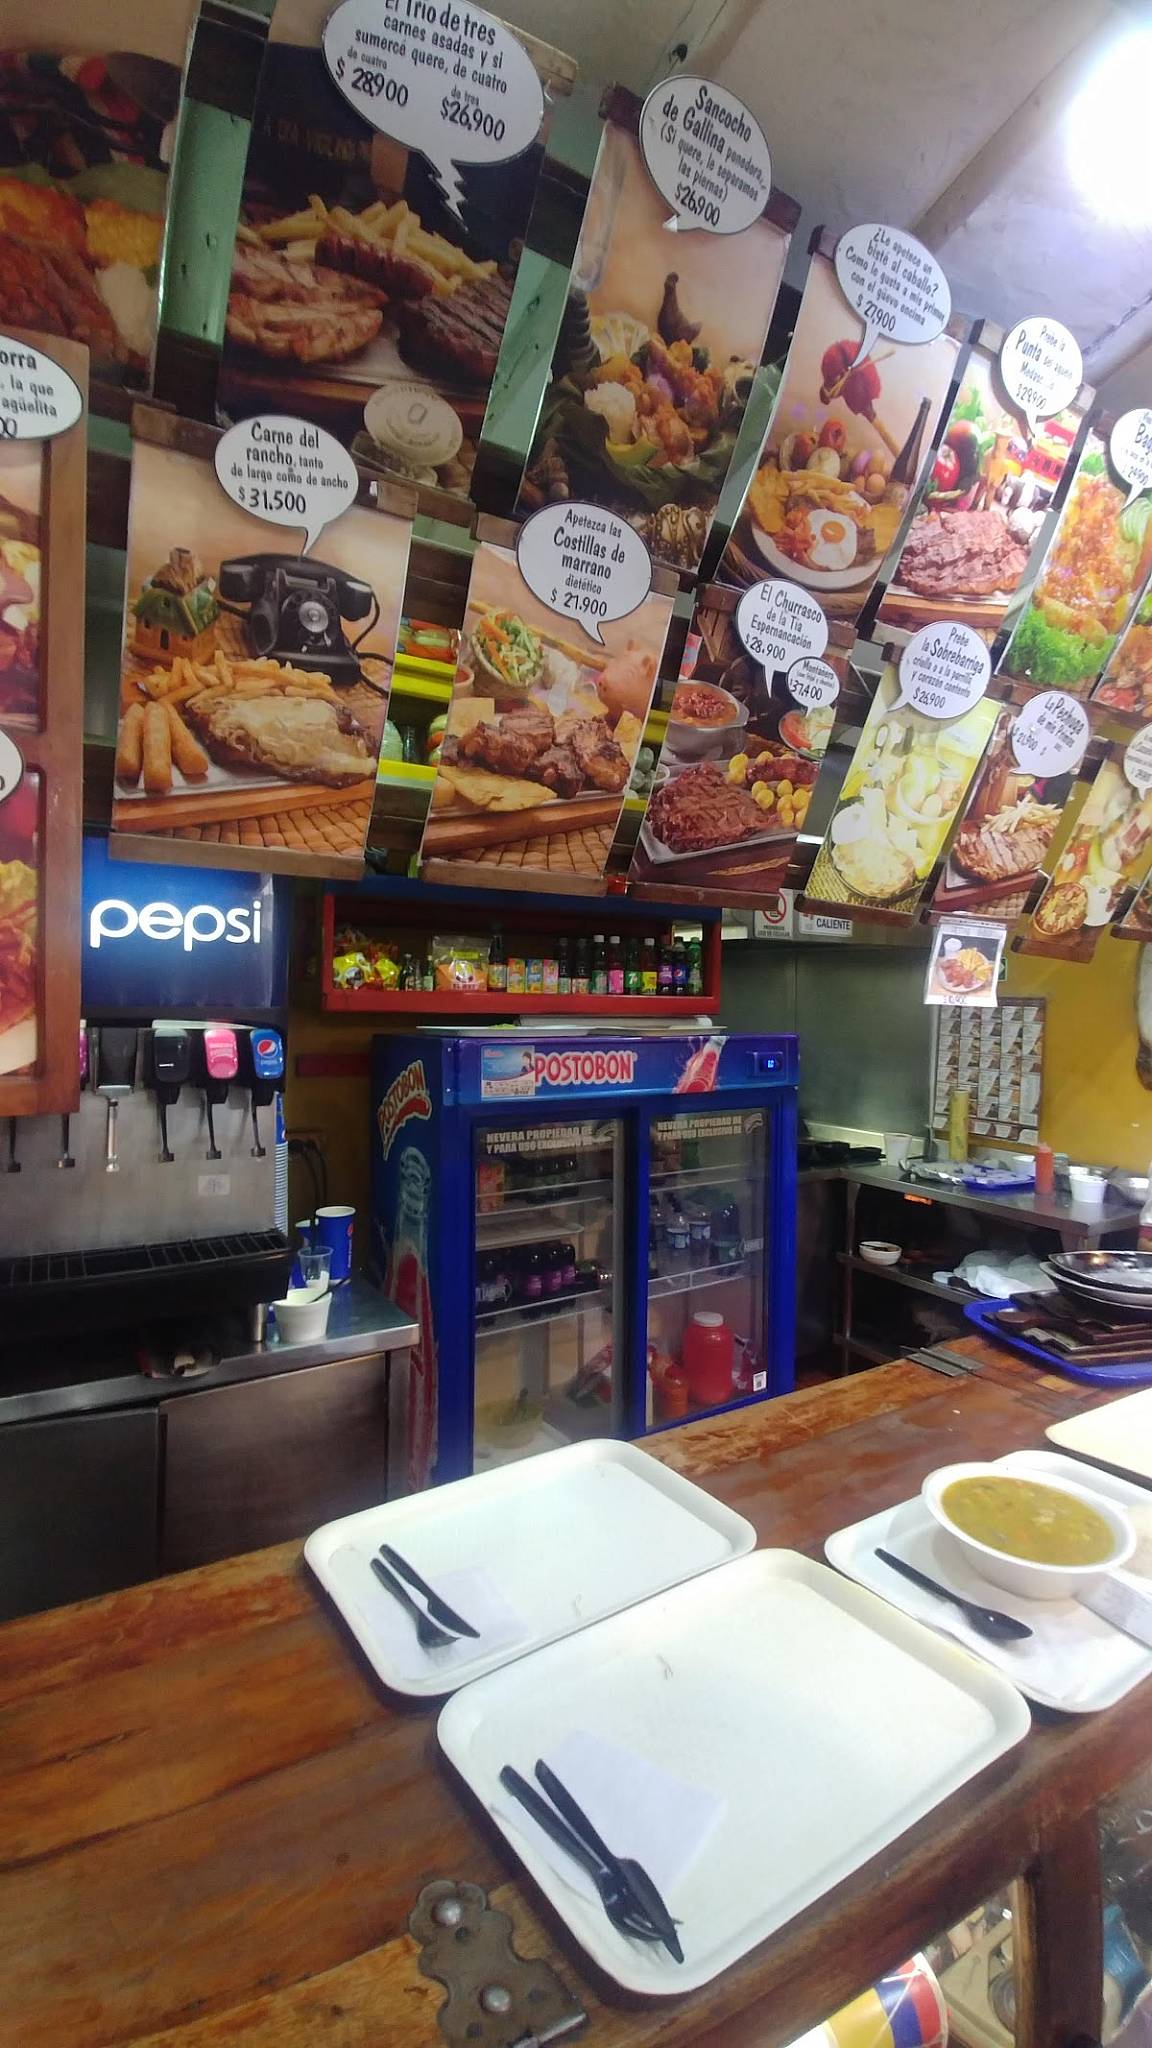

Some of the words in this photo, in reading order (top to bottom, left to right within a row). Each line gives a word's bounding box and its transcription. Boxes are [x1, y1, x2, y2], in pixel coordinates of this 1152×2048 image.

[440, 4, 460, 31] de
[464, 13, 496, 46] tres
[384, 16, 425, 42] carnes
[432, 33, 475, 59] asadas
[480, 50, 487, 67] y
[492, 51, 504, 70] si
[347, 47, 358, 60] de
[361, 52, 388, 70] cuatro
[453, 59, 467, 78] de
[471, 70, 507, 94] cuatro
[451, 85, 462, 98] de
[464, 91, 480, 105] tres
[663, 94, 679, 121] de
[684, 106, 725, 154] Gallina
[696, 85, 751, 143] Sancocho
[678, 157, 691, 178] las
[706, 152, 715, 171] le
[846, 246, 868, 270] Como
[880, 272, 900, 291] gusta
[903, 287, 908, 296] a
[851, 272, 865, 286] con
[868, 281, 875, 292] el
[891, 260, 901, 274] al
[902, 268, 938, 297] caballo?
[923, 263, 932, 275] un
[1015, 329, 1042, 361] Punta
[10, 374, 23, 392] la
[29, 382, 54, 397] que
[251, 420, 293, 445] Carne
[300, 428, 320, 449] del
[299, 455, 324, 470] tanto
[231, 463, 243, 477] de
[247, 464, 273, 483] largo
[276, 472, 302, 484] como
[306, 471, 317, 486] de
[321, 473, 349, 489] ancho
[565, 508, 607, 532] Apetezca
[609, 522, 622, 538] las
[553, 526, 607, 559] Costillas
[610, 543, 626, 563] de
[561, 554, 612, 580] marrano
[565, 573, 602, 595] dietético
[760, 583, 772, 602] El
[775, 590, 822, 623] Churrasco
[767, 608, 776, 622] de
[780, 610, 786, 626] la
[921, 637, 929, 652] la
[930, 638, 984, 676] Sobrebarriga
[911, 670, 916, 682] y
[944, 667, 950, 677] la
[90, 899, 261, 952] pepsi
[816, 918, 851, 931] CALIENTE
[535, 1051, 633, 1084] POSTOBON
[487, 1130, 525, 1143] NEVERA
[527, 1127, 579, 1140] PROPIEDAD
[487, 1144, 492, 1154] Y
[494, 1143, 517, 1154] PARA
[519, 1141, 536, 1152] USO
